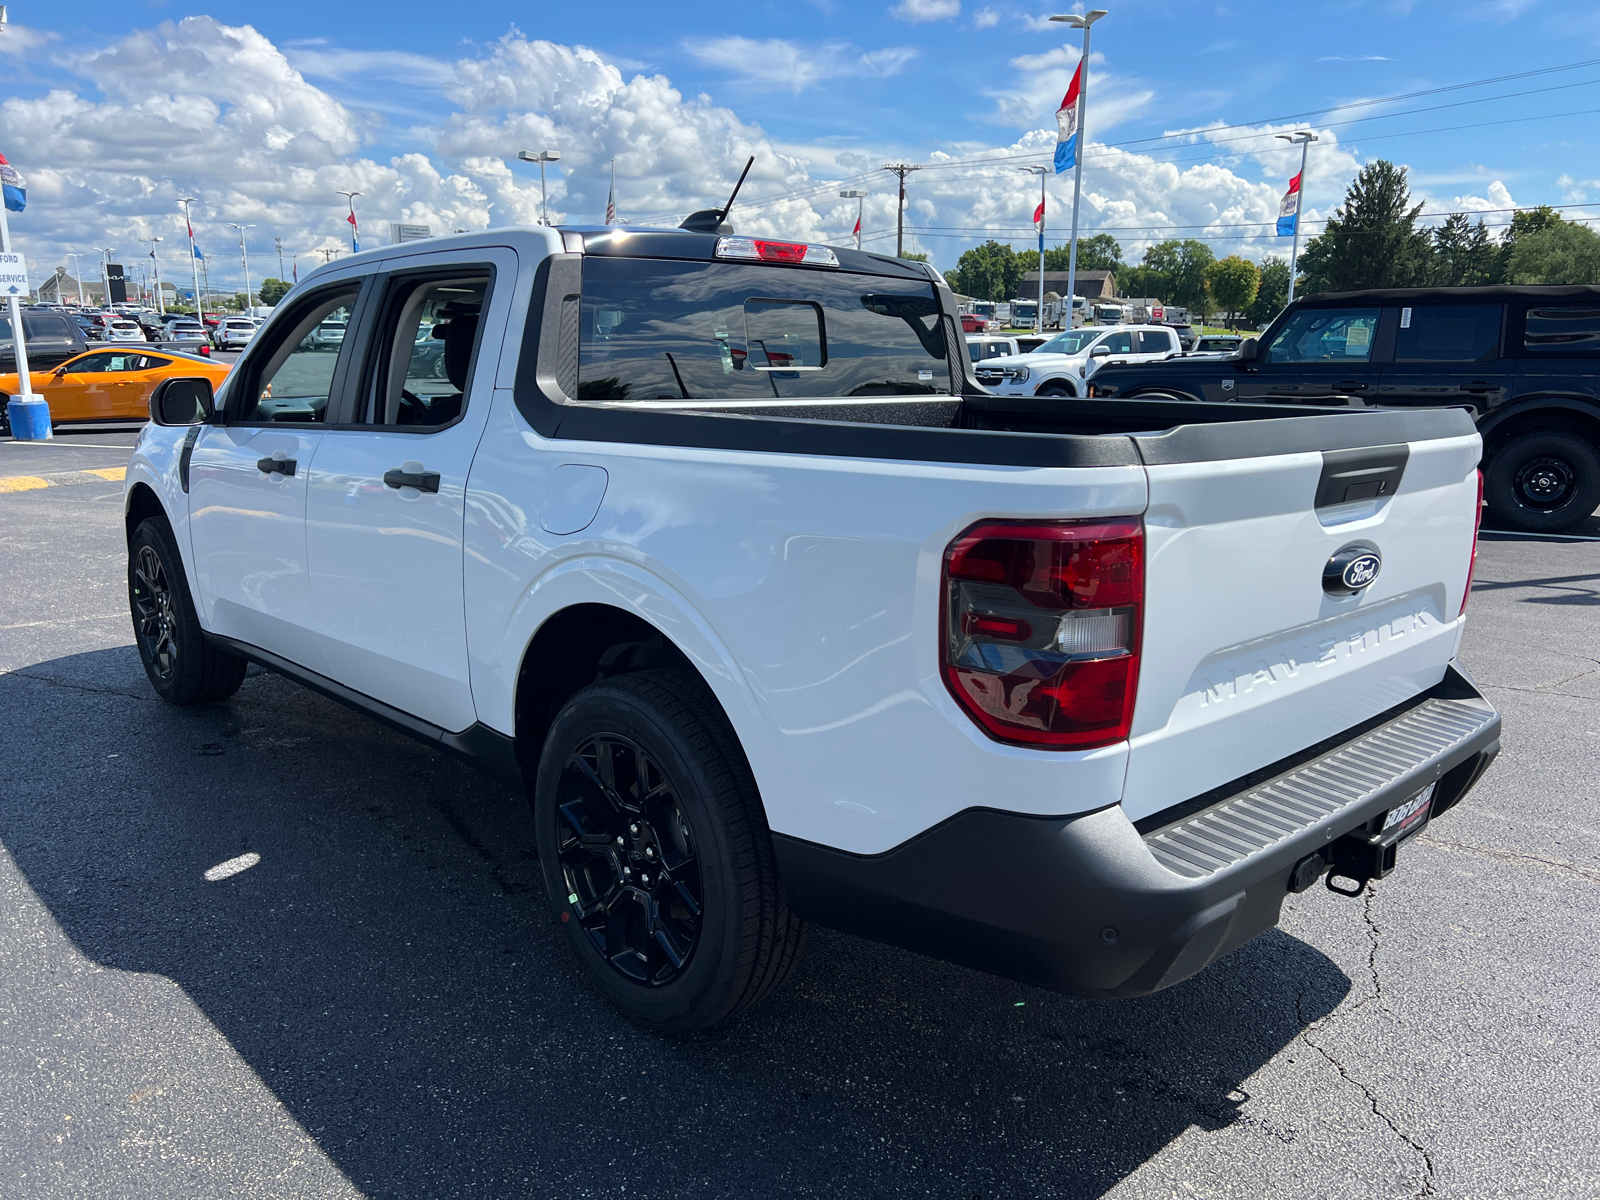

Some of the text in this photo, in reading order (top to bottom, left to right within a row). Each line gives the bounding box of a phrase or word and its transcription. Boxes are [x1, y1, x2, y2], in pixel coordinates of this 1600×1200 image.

[0, 255, 18, 263] FORD
[0, 274, 26, 283] SERVICE
[1349, 559, 1376, 584] Ford
[1200, 605, 1428, 708] MAVERICK
